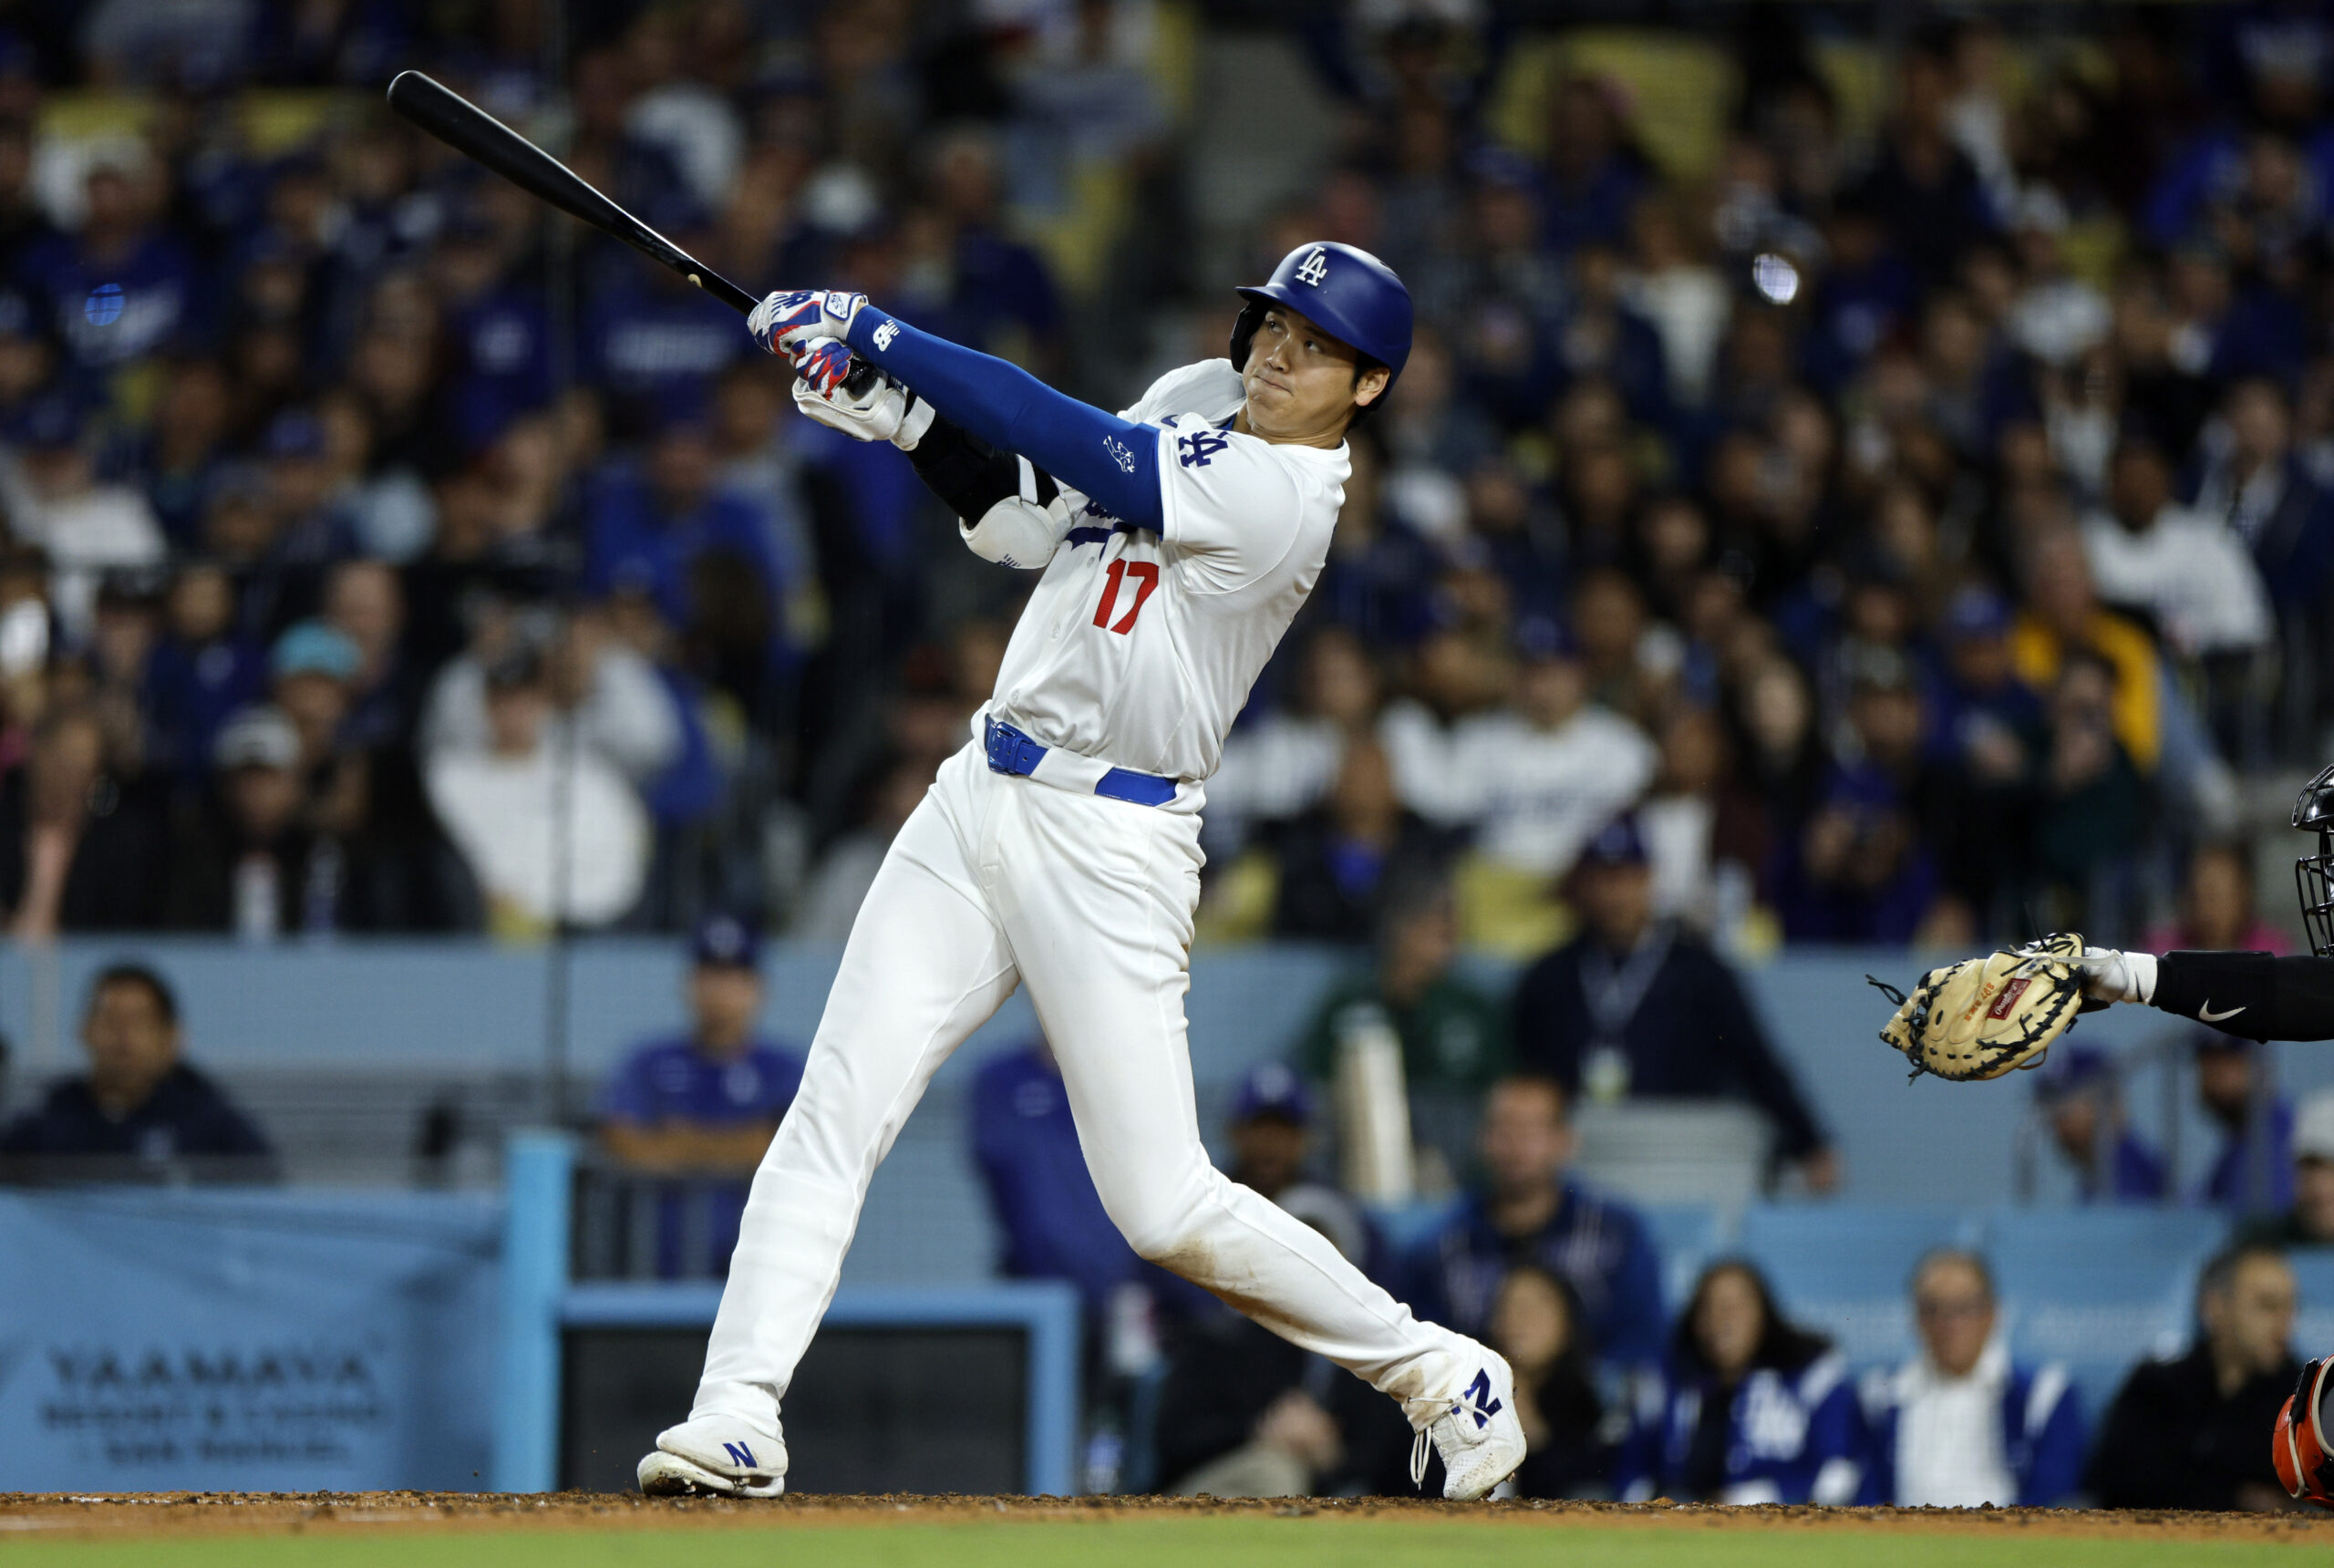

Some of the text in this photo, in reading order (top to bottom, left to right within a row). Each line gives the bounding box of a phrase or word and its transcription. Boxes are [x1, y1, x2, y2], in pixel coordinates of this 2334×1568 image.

[1295, 246, 1327, 287] LA
[1092, 557, 1160, 635] 17
[1463, 1367, 1503, 1430] N
[722, 1440, 758, 1469] N
